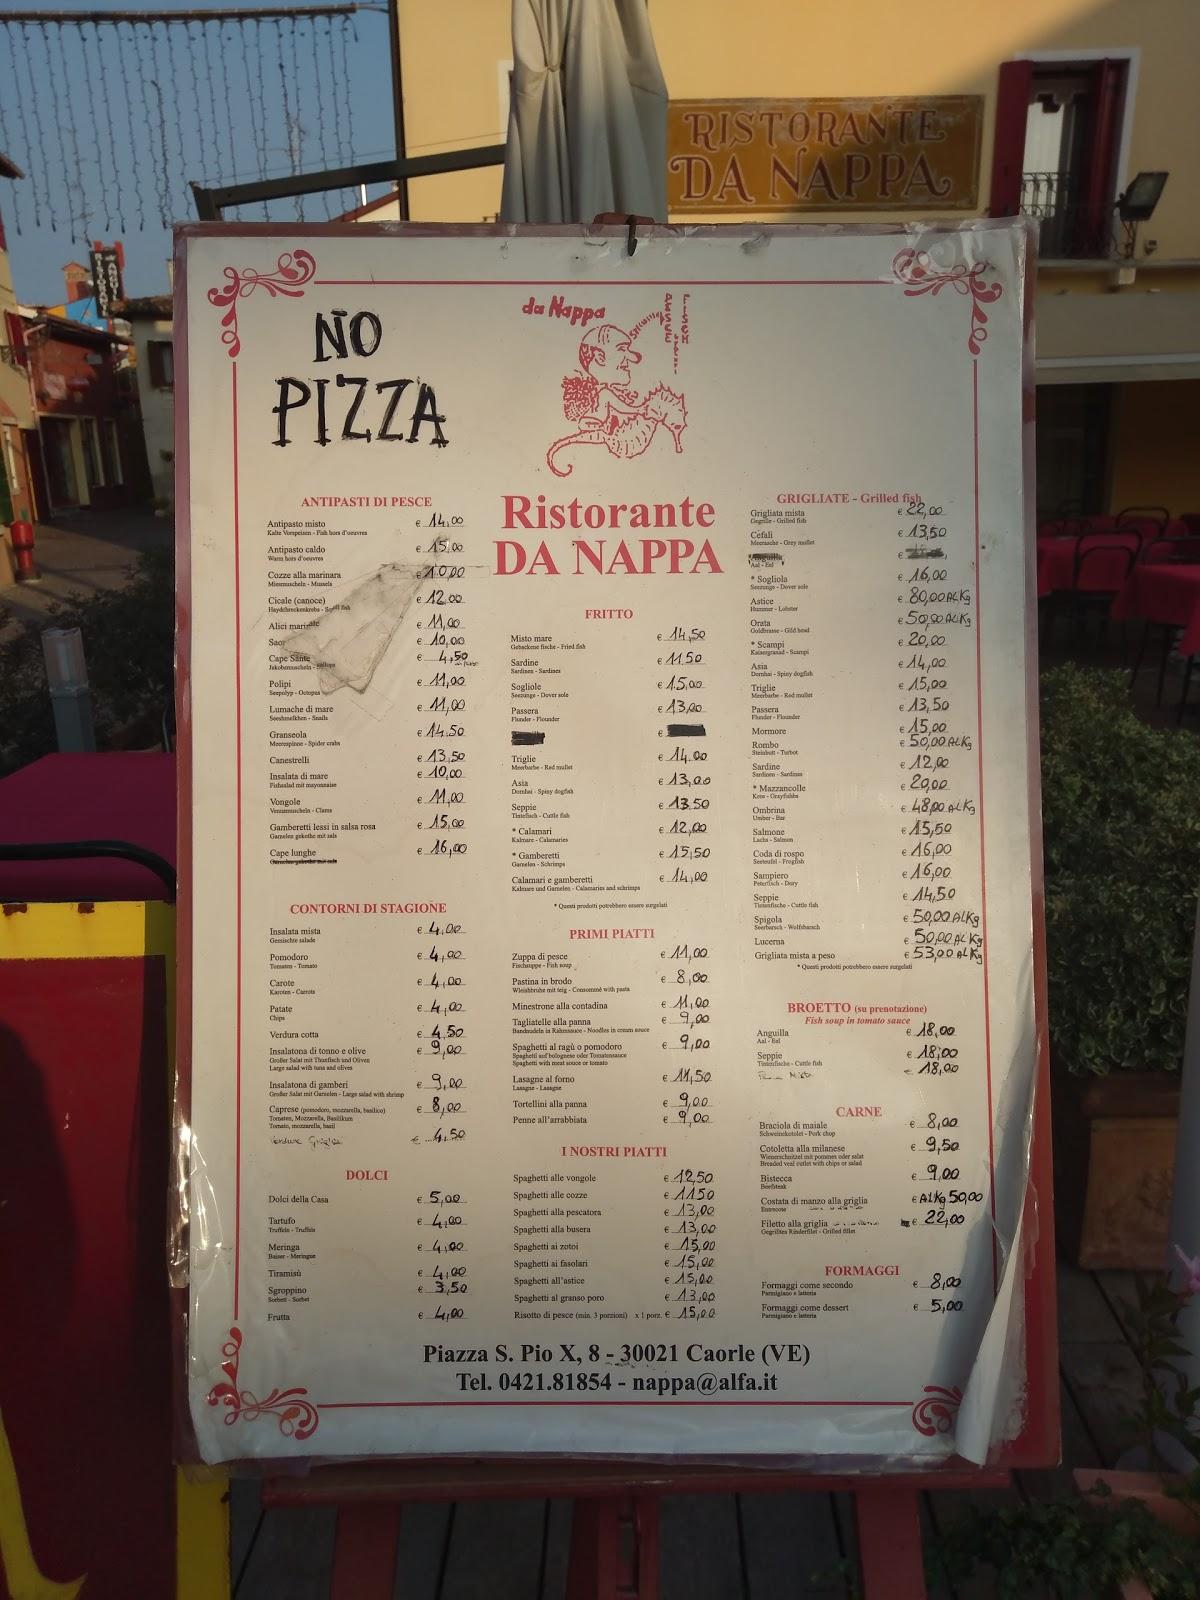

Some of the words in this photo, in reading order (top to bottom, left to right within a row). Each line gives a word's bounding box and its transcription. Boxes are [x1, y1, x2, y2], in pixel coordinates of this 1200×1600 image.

[684, 104, 946, 151] RISTORANTE
[670, 153, 755, 204] DA
[768, 146, 952, 202] NAPPA
[522, 296, 545, 315] da
[548, 295, 606, 327] Nappa
[312, 308, 383, 363] NO
[271, 373, 450, 448] PIZZA
[301, 497, 372, 507] ANTIPASTI
[373, 497, 387, 507] DI
[391, 496, 433, 507] PESCE
[776, 493, 850, 504] GRIGLIATE
[860, 493, 899, 504] Grilled
[501, 494, 716, 529] Ristorante
[750, 509, 783, 519] Grigliata
[784, 509, 805, 517] mista
[267, 520, 304, 529] Antipasto
[305, 520, 326, 528] misto
[750, 531, 773, 539] Cefali
[493, 540, 561, 576] DA
[572, 538, 725, 576] NAPPA
[267, 571, 289, 579] Cozze
[290, 571, 306, 579] alla
[307, 571, 342, 579] marinara
[757, 575, 788, 585] Sogliola
[268, 596, 292, 605] Cicale
[293, 596, 326, 605] (canoce)
[750, 597, 774, 606] Astice
[585, 609, 633, 619] FRITTO
[750, 619, 771, 627] Orata
[510, 634, 531, 643] Misto
[532, 635, 552, 643] mare
[757, 640, 785, 650] Scampi
[510, 659, 539, 667] Sardine
[269, 680, 292, 689] Polipi
[511, 683, 542, 693] Sogliole
[269, 705, 304, 713] Lumache
[305, 705, 312, 713] di
[511, 707, 539, 715] Passera
[269, 731, 307, 739] Granseola
[752, 727, 787, 736] Mormore
[752, 741, 779, 749] Rombo
[269, 756, 310, 764] Canestrelli
[511, 755, 536, 765] Triglie
[759, 784, 806, 792] Mazzancolle
[270, 798, 301, 807] Vongole
[511, 804, 537, 813] Seppie
[752, 806, 786, 814] Ombrina
[270, 823, 312, 831] Gamberetti
[313, 823, 330, 831] lessi
[331, 823, 339, 831] in
[340, 823, 359, 831] salsa
[518, 827, 552, 835] Calamari
[752, 828, 785, 836] Salmone
[518, 852, 560, 860] Gamberetti
[753, 872, 789, 881] Sampiero
[290, 903, 362, 915] CONTORNI
[363, 903, 378, 914] DI
[380, 903, 447, 914] STAGIONE
[754, 915, 783, 925] Spigola
[269, 927, 299, 936] Insalata
[300, 927, 321, 935] mista
[569, 929, 608, 940] PRIMI
[612, 928, 656, 939] PIATTI
[754, 937, 785, 946] Lucerna
[269, 953, 309, 961] Pomodoro
[512, 953, 536, 962] Zuppa
[537, 952, 546, 960] di
[547, 953, 568, 962] pesce
[269, 979, 295, 988] Carote
[269, 1005, 293, 1013] Patate
[512, 1002, 555, 1010] Minestrone
[556, 1002, 571, 1010] alla
[572, 1002, 608, 1010] contadina
[787, 1002, 851, 1013] BROETTO
[854, 1005, 868, 1014] (su
[869, 1005, 928, 1014] prenotazione)
[805, 1016, 823, 1025] Fish
[825, 1017, 845, 1025] soup
[847, 1016, 855, 1025] in
[856, 1016, 885, 1025] tomato
[887, 1017, 911, 1025] sauce
[756, 1029, 789, 1038] Anguilla
[836, 1106, 882, 1118] CARNE
[513, 1116, 536, 1124] Penne
[537, 1116, 588, 1124] all'arrabbiata
[759, 1121, 791, 1130] Braciola
[793, 1121, 801, 1129] di
[802, 1121, 828, 1129] maiale
[562, 1147, 568, 1157] I
[570, 1147, 620, 1157] NOSTRI
[623, 1146, 668, 1157] PIATTI
[346, 1169, 388, 1181] DOLCI
[513, 1174, 549, 1184] Spaghetti
[550, 1174, 564, 1182] alle
[566, 1174, 597, 1183] vongole
[760, 1174, 793, 1183] Bistecca
[268, 1195, 290, 1203] Dolci
[292, 1195, 310, 1203] della
[311, 1195, 329, 1203] Casa
[513, 1209, 549, 1218] Spaghetti
[566, 1209, 602, 1218] pescatora
[268, 1217, 296, 1225] Tartufo
[268, 1243, 300, 1253] Meringa
[268, 1269, 302, 1278] Tiramisù
[824, 1265, 900, 1277] FORMAGGI
[761, 1281, 798, 1291] Formaggi
[822, 1281, 854, 1289] secondo
[268, 1286, 307, 1296] Sgroppino
[267, 1313, 290, 1322] Frutta
[423, 1344, 489, 1365] Piazza
[494, 1344, 514, 1364] S.
[521, 1344, 553, 1364] Pio
[559, 1344, 582, 1365] X,
[589, 1344, 600, 1364] 8
[620, 1344, 679, 1364] 30021
[686, 1344, 755, 1364] Caorle
[760, 1343, 811, 1367] (VE)
[456, 1372, 493, 1392] Tel.
[499, 1372, 612, 1392] 0421.81854
[632, 1372, 778, 1395] nappa@alfa.it
